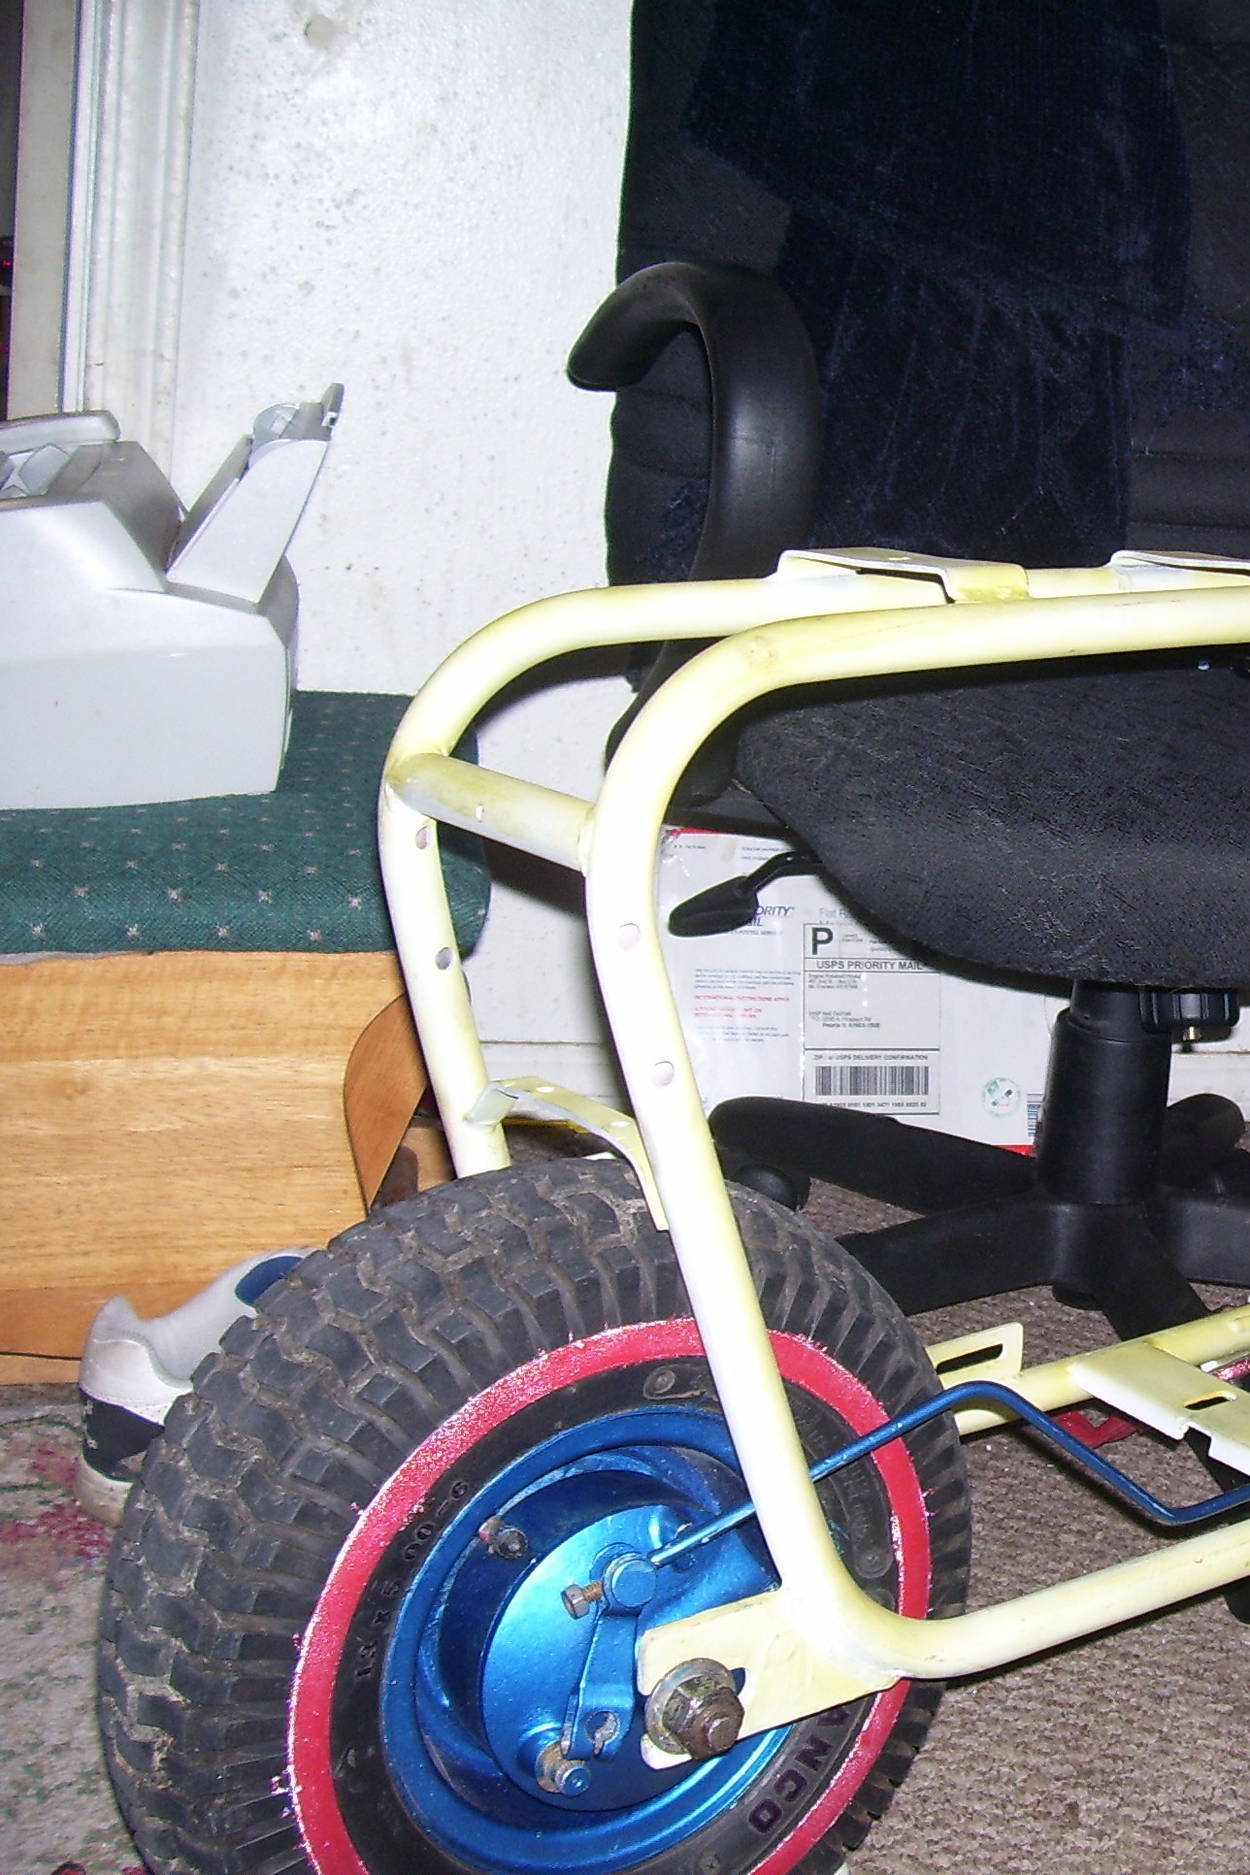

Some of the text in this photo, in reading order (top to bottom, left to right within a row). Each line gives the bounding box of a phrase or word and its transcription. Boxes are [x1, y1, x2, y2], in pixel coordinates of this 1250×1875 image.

[755, 905, 791, 916] ORITY
[811, 927, 833, 955] P
[816, 960, 923, 970] USPS PRIORITY MAIL
[748, 1706, 851, 1833] ANCO
